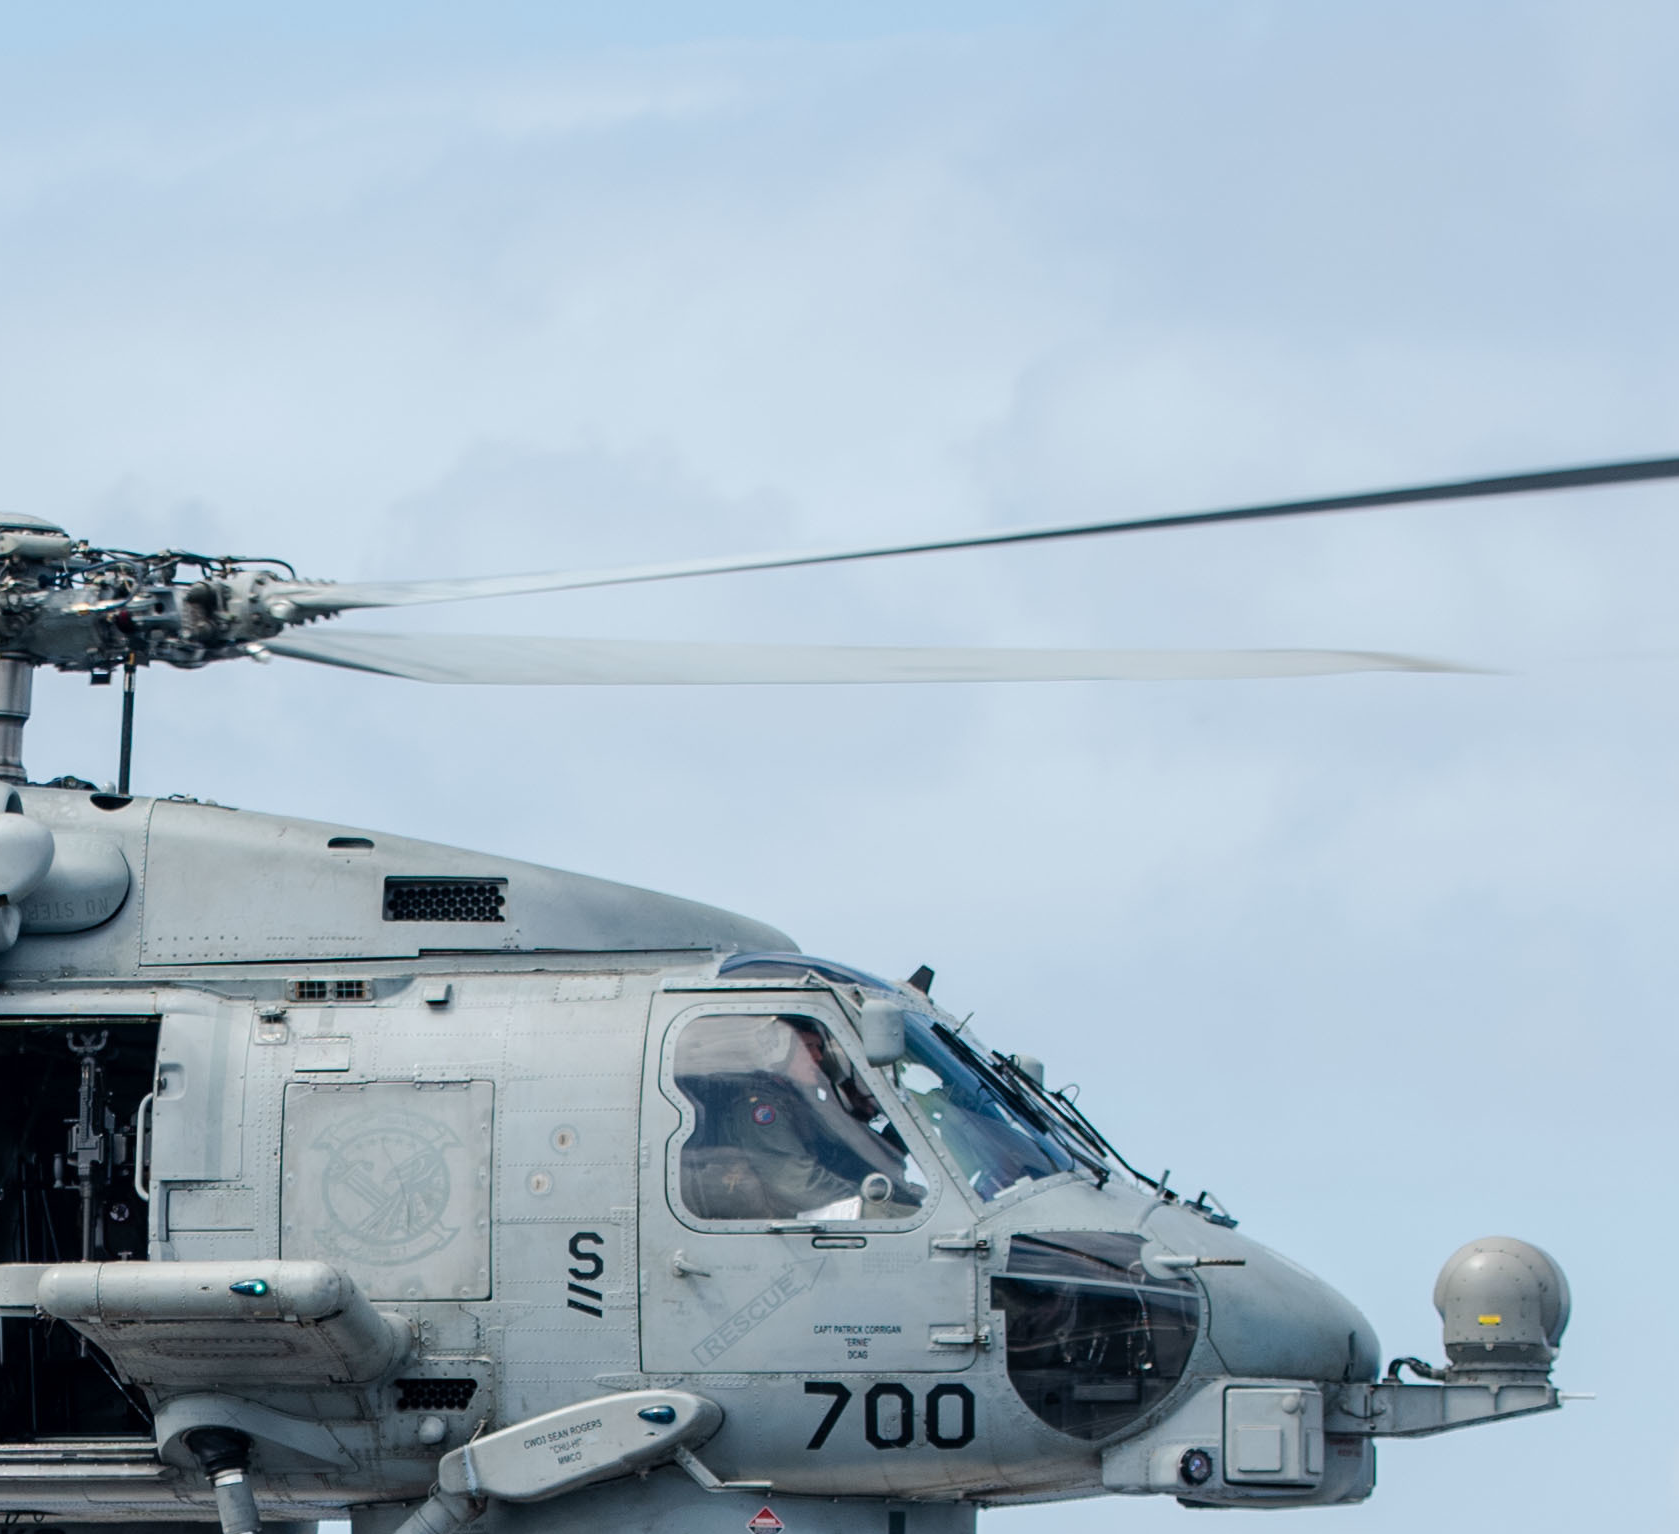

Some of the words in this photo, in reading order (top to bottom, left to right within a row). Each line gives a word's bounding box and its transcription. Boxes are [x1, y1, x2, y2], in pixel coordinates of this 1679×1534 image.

[568, 1231, 604, 1280] S
[703, 1275, 798, 1357] RESCUE
[813, 1325, 832, 1335] CAPT
[833, 1325, 862, 1335] PATRICK
[864, 1325, 902, 1335] CORRIGAN
[547, 1429, 569, 1442] SEAN
[569, 1419, 603, 1436] ROGERS
[804, 1381, 976, 1450] 700
